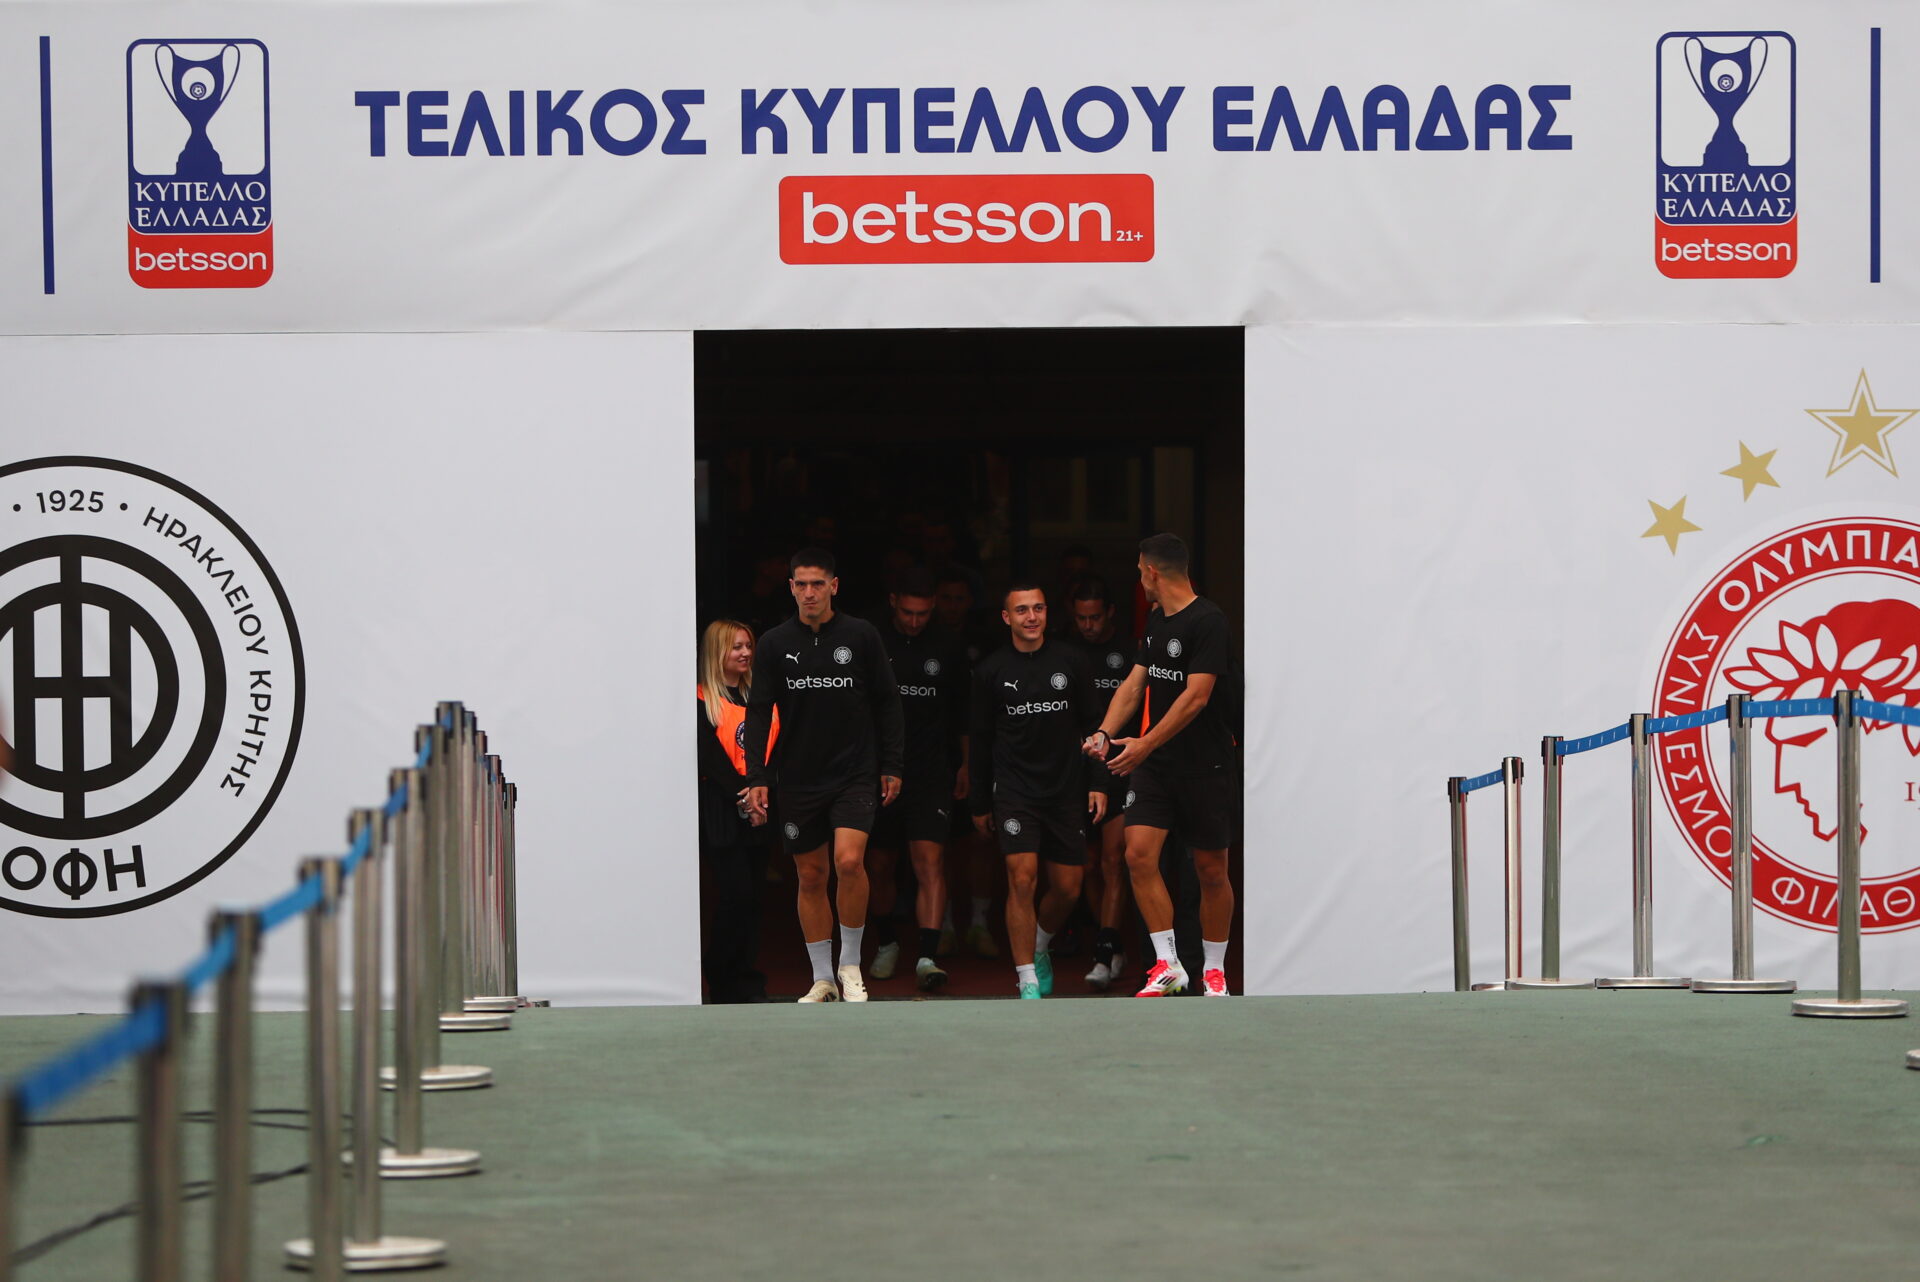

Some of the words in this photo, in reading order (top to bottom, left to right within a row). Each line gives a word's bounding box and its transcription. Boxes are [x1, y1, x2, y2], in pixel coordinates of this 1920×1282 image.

[355, 88, 707, 157] ΤΕΛΙΚΟΣ
[741, 85, 1185, 155] ΚΥΠΕΛΛΟΥ
[1213, 84, 1573, 152] ΕΛΛΑΔΑΣ
[134, 181, 266, 202] ΚΥΠΕΛΛΟ
[1662, 172, 1792, 193] ΚΥΠΕΛΛΟ
[135, 206, 267, 227] ΕΛΛΑΔΑΣ
[802, 190, 1112, 245] betsson
[1116, 229, 1144, 242] 21+
[1662, 197, 1792, 218] ΕΛΛΑΔΑΣ
[135, 246, 267, 271] betsson
[1661, 237, 1792, 262] betsson
[36, 489, 104, 514] 1925
[142, 506, 269, 655] ΗΡΑΚΛΕΙΟΥ
[219, 670, 272, 797] ΚΡΗΤΗΣ
[785, 675, 853, 690] betsson
[1005, 700, 1069, 716] betsson
[1664, 622, 1760, 873] ΣΥΝΕΣΜΟ
[1, 844, 147, 901] ΟΦΗ
